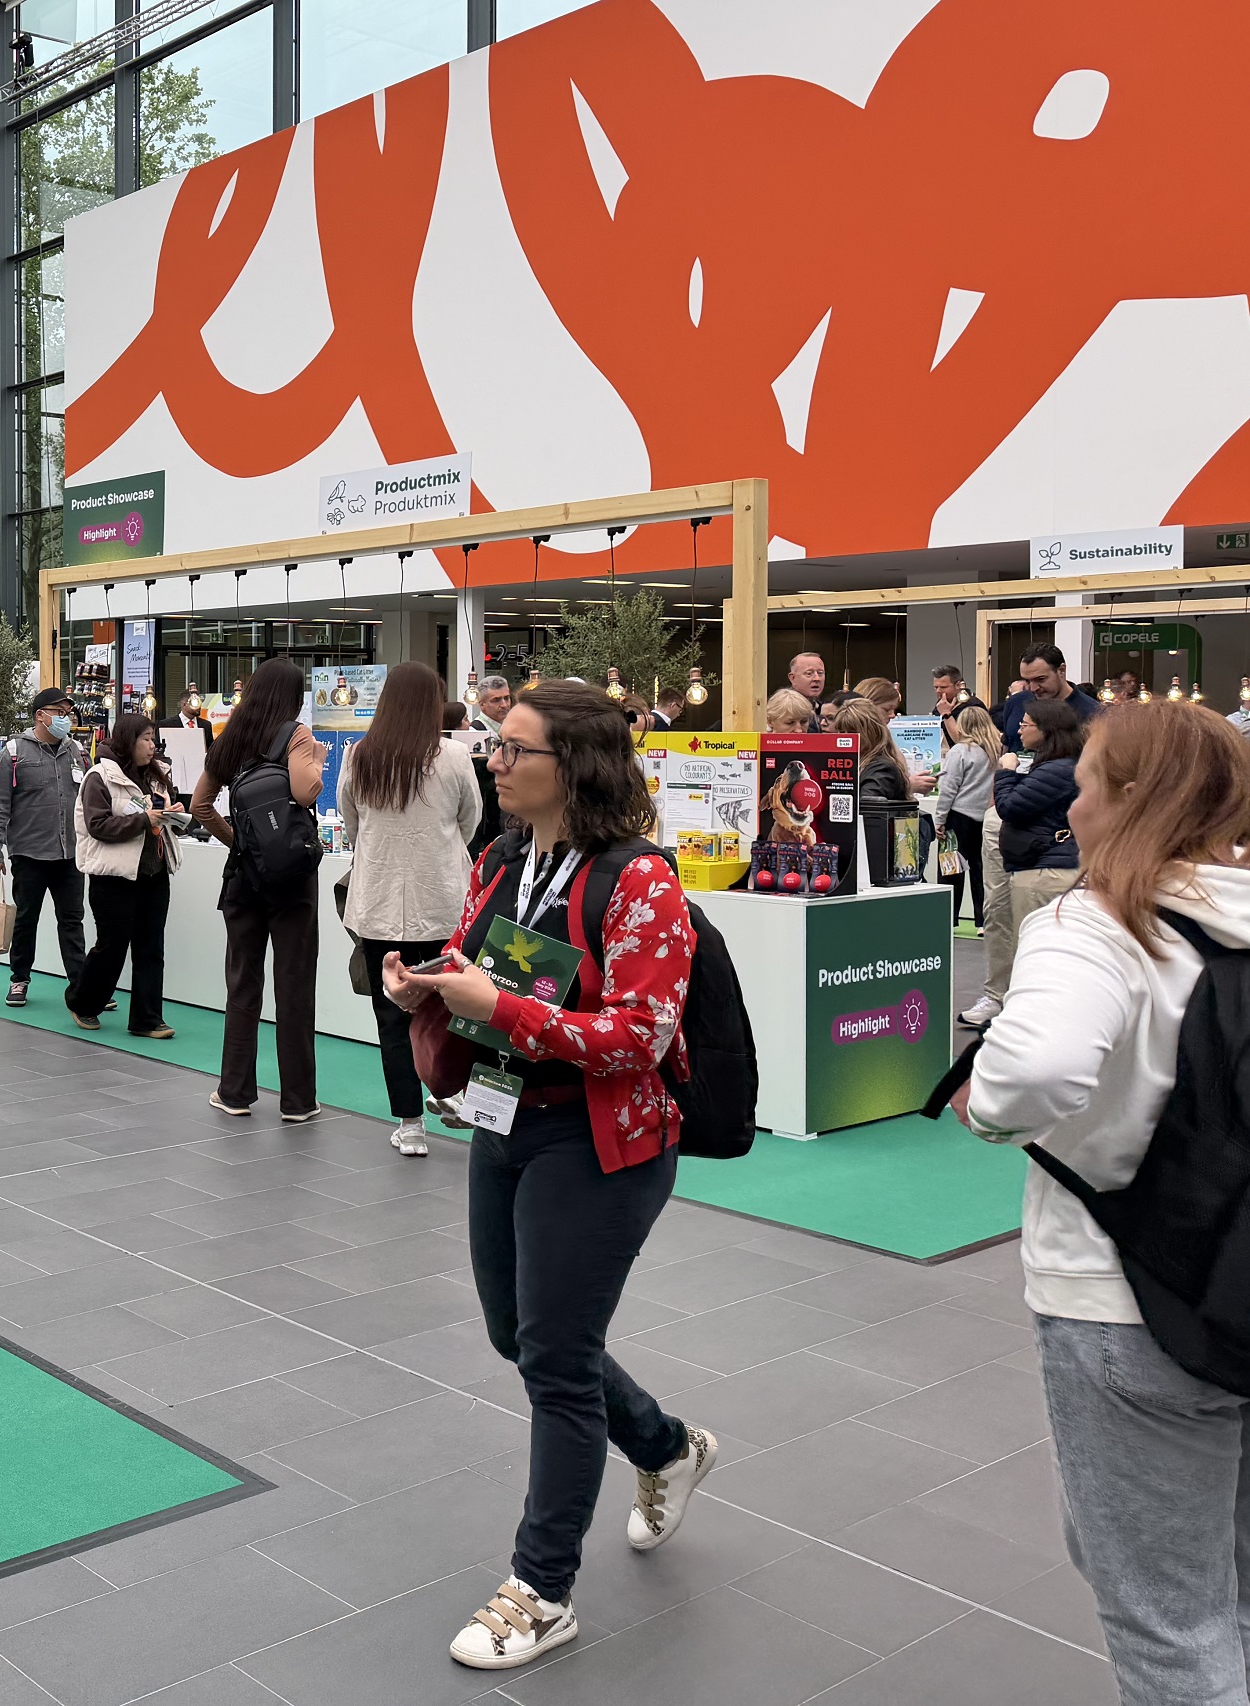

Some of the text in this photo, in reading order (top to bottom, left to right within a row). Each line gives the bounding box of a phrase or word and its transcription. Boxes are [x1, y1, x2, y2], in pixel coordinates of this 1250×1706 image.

[375, 469, 461, 496] Productmix
[72, 488, 154, 510] Product Showcase
[374, 491, 456, 515] Produktmix
[84, 528, 116, 542] Highlight
[1069, 543, 1173, 560] Sustainability
[1113, 632, 1160, 644] COPELE
[704, 740, 734, 750] Tropical
[828, 759, 853, 768] RED
[821, 770, 853, 780] BALL
[818, 956, 942, 988] Product Showcase
[840, 1014, 890, 1038] Highlight
